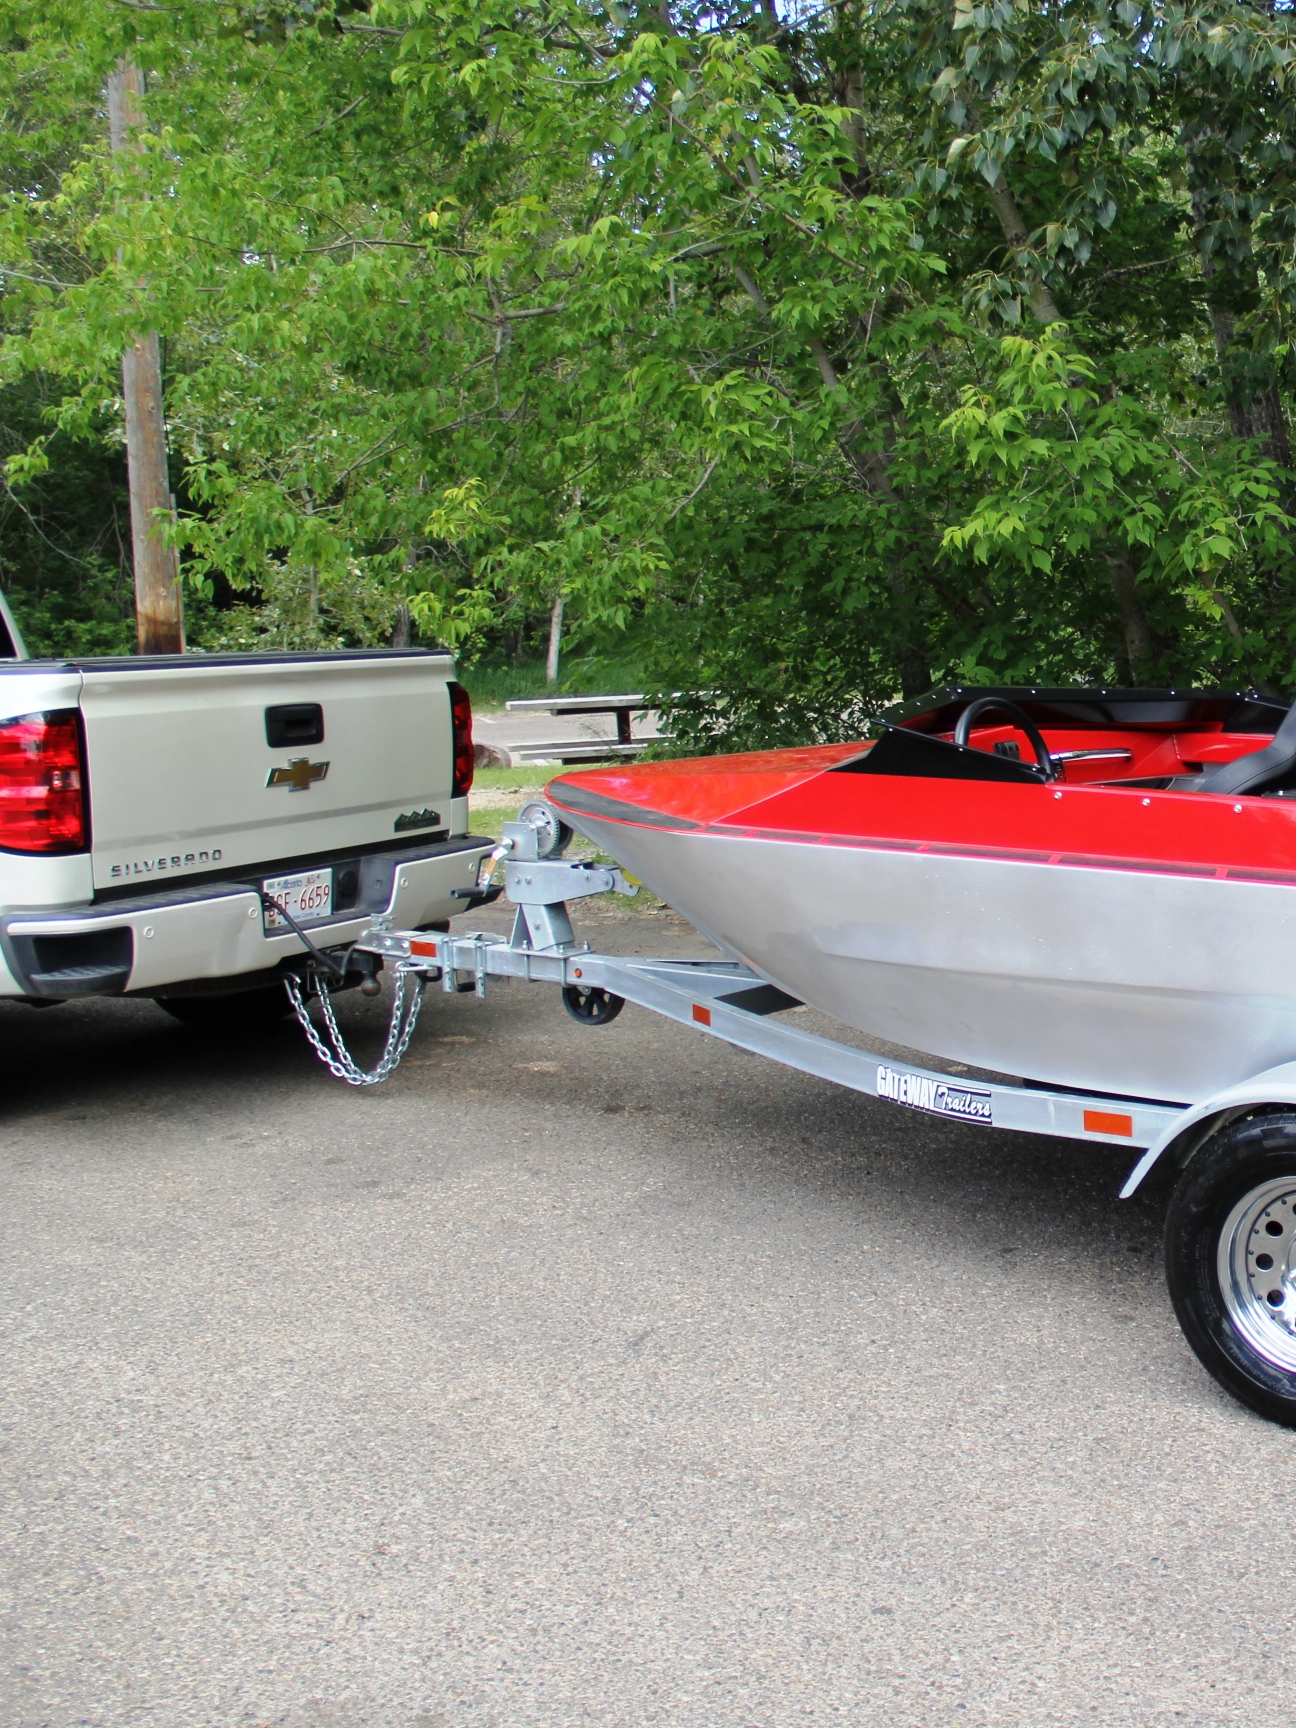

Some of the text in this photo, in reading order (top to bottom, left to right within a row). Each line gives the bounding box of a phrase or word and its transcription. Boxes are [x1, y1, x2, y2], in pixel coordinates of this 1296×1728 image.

[111, 849, 222, 877] SILVERADO
[876, 1064, 992, 1116] GATEWAY Trailers
